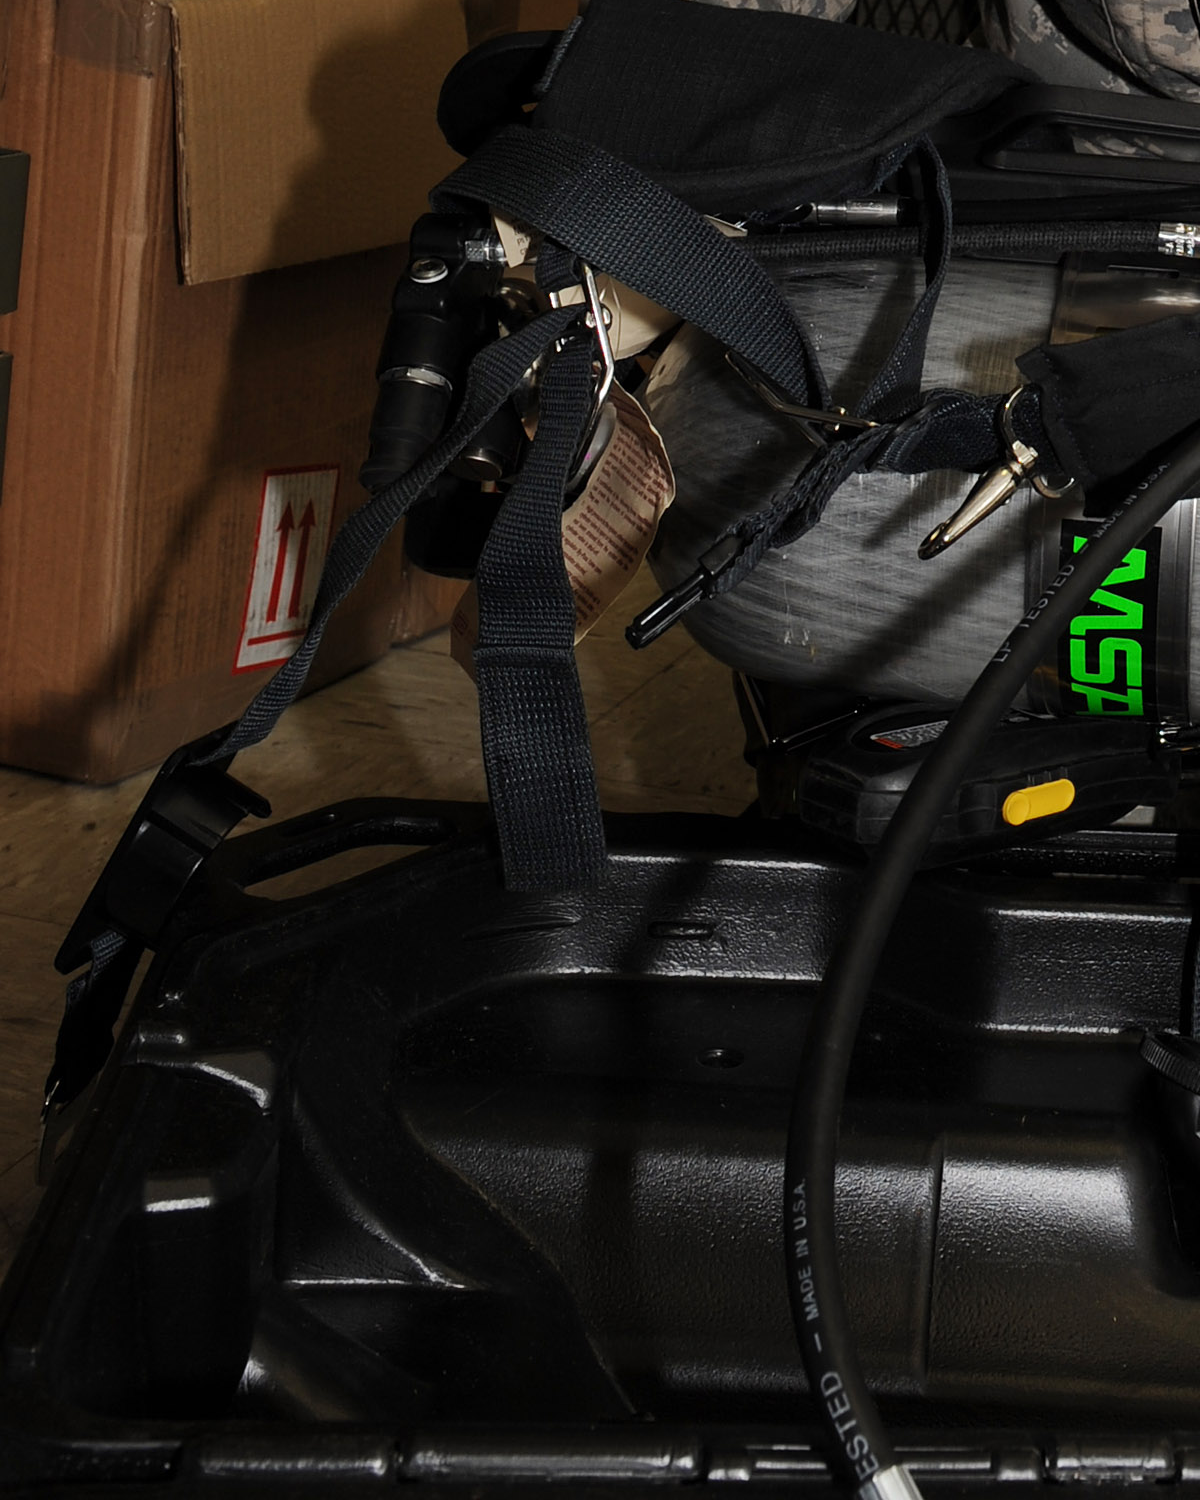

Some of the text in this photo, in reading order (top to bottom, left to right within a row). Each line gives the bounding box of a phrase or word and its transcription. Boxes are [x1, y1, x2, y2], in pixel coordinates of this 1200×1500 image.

[793, 1178, 808, 1232] U.S.A.
[794, 1241, 810, 1260] IN
[794, 1266, 821, 1322] MADE
[821, 1370, 879, 1481] ESTED
